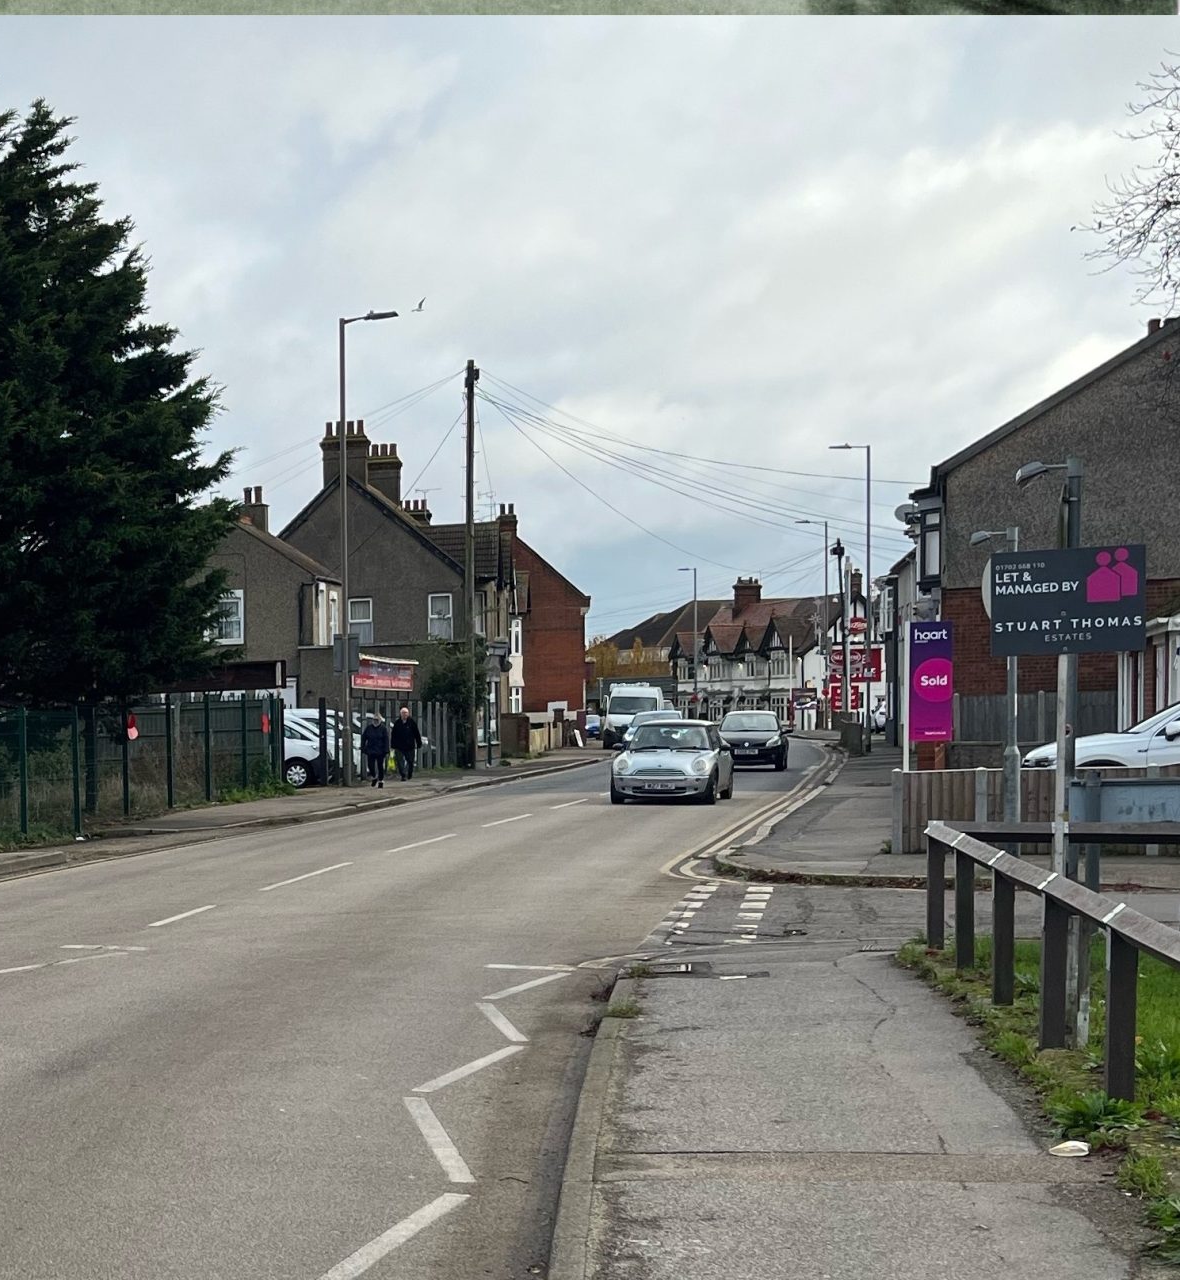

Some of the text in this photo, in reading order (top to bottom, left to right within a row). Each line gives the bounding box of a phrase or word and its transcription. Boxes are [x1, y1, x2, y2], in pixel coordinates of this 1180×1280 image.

[995, 571, 1032, 584] LET &
[995, 580, 1080, 596] MANAGED BY
[994, 615, 1143, 633] STUART THOMAS
[914, 628, 948, 640] haart
[1044, 632, 1092, 642] ESTATES
[920, 674, 948, 686] Sold
